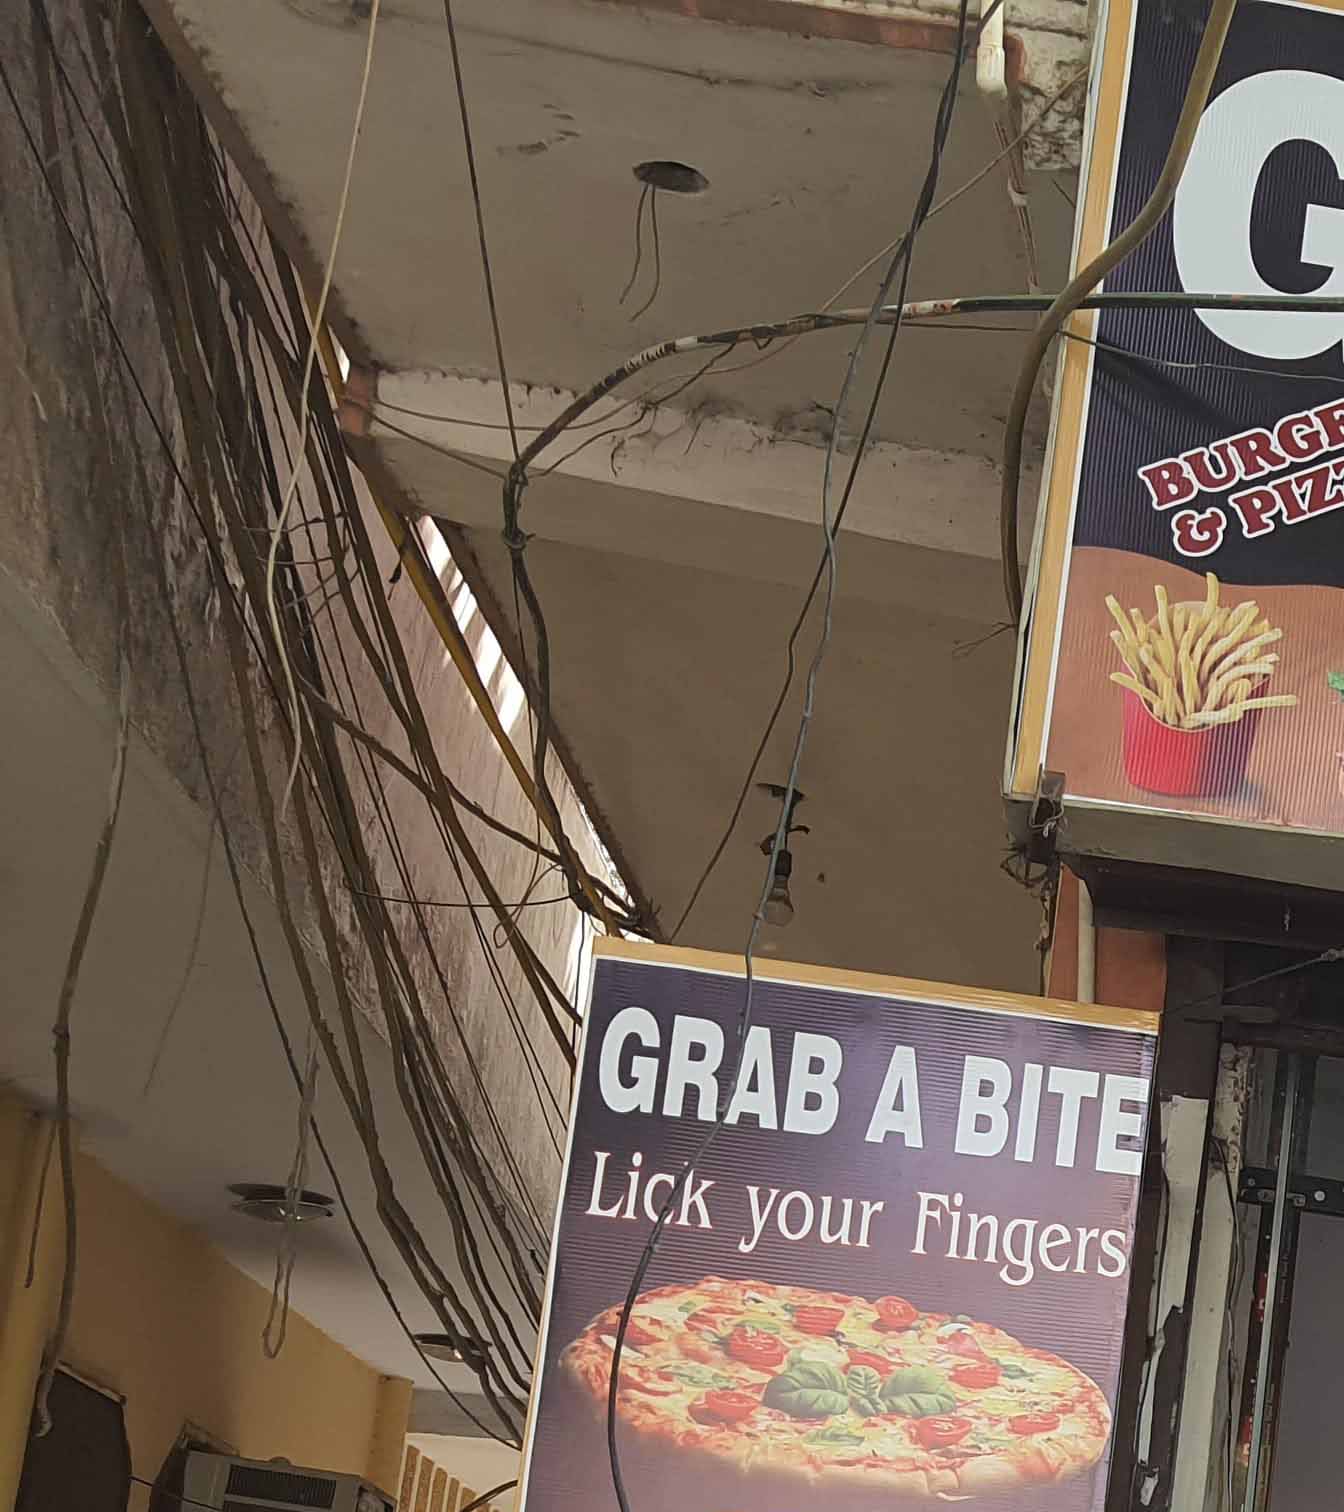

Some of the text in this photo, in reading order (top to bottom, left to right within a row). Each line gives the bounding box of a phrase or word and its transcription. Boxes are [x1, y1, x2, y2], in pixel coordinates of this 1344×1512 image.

[1171, 508, 1227, 557] &
[598, 1006, 1152, 1177] GRAB A BITE
[584, 1151, 1128, 1287] Lick your Fingers
